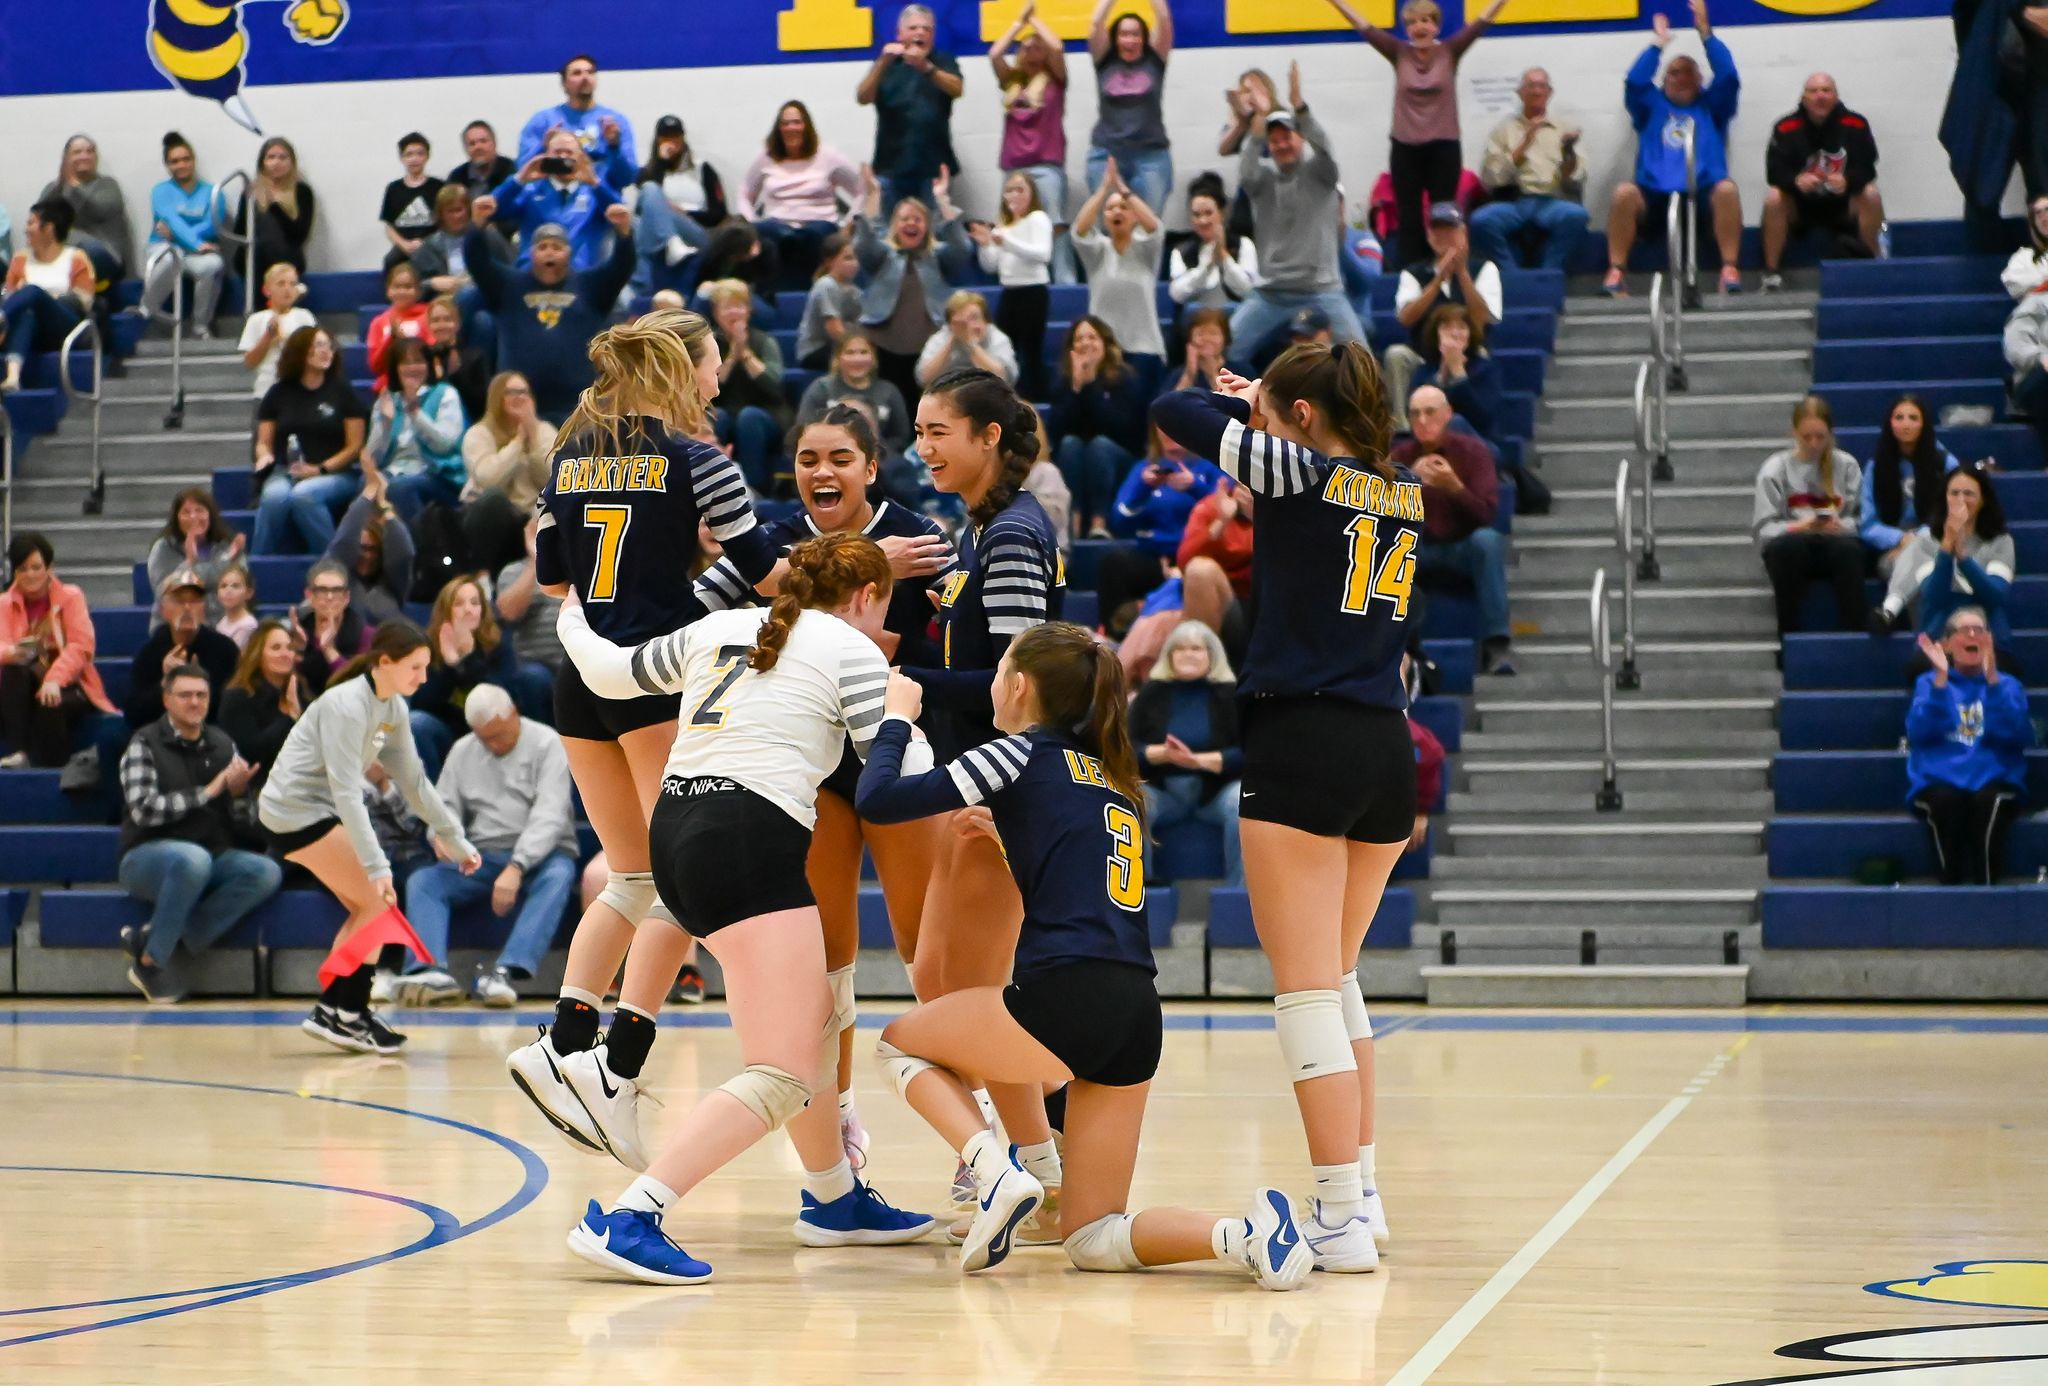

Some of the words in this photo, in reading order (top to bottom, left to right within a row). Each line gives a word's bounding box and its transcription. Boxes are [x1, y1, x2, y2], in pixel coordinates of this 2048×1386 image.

[556, 455, 669, 494] BAXTER
[584, 504, 632, 603] 7
[1341, 513, 1418, 621] 14
[688, 645, 758, 730] 2
[688, 779, 736, 796] NIKE
[1104, 802, 1145, 912] 3
